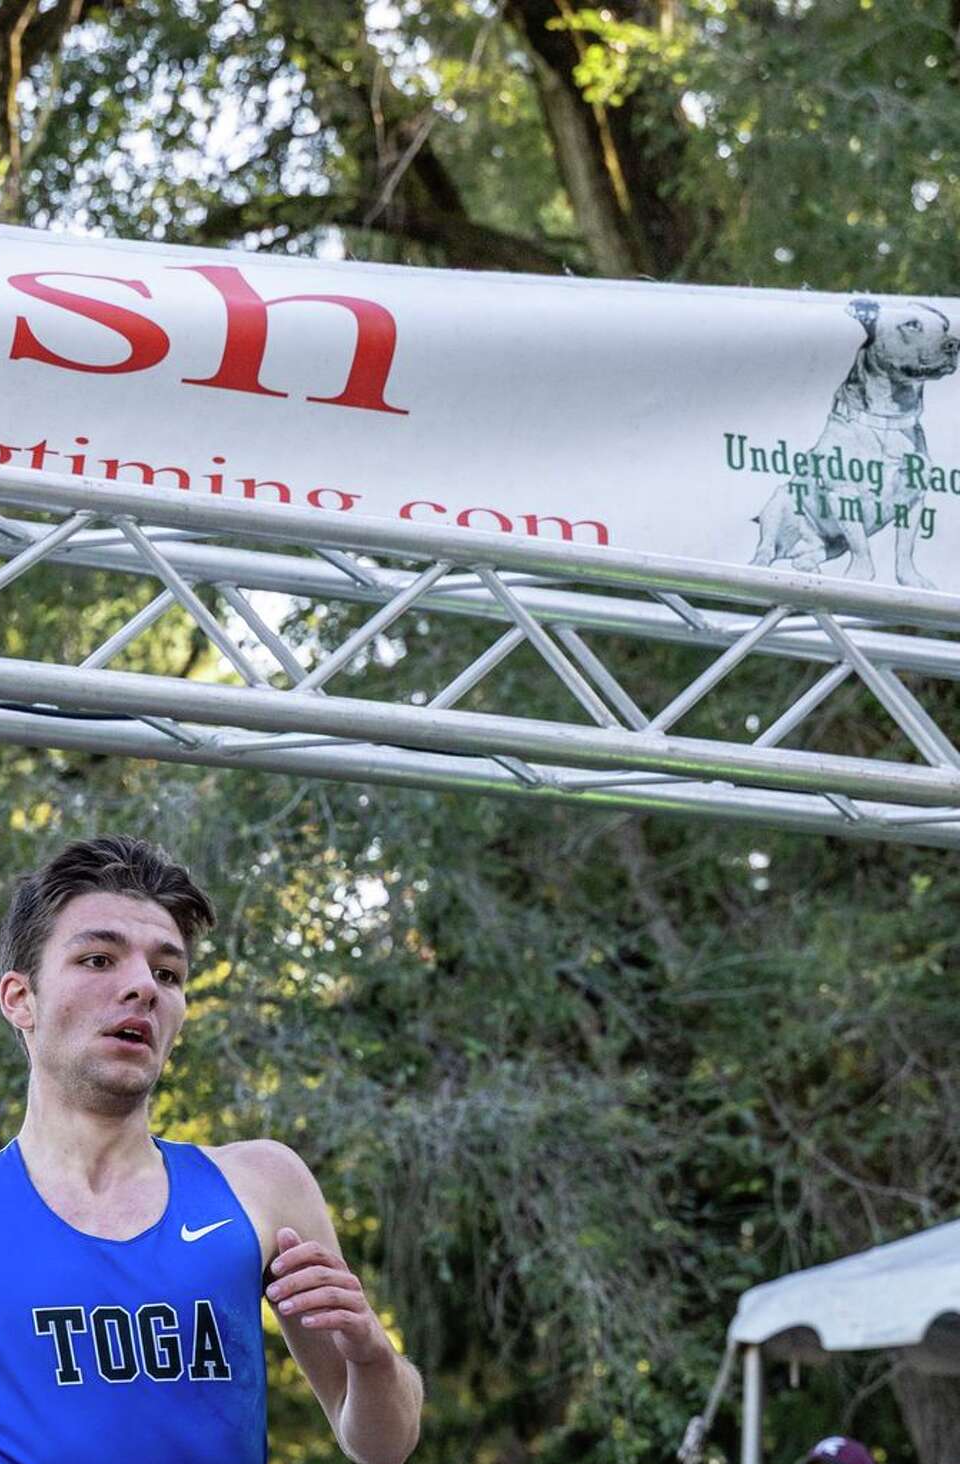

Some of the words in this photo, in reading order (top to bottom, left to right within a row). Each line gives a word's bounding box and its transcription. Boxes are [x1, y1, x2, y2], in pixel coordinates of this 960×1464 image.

[724, 433, 884, 496] Underdog
[788, 482, 937, 540] Timing
[32, 1300, 233, 1386] TOGA
